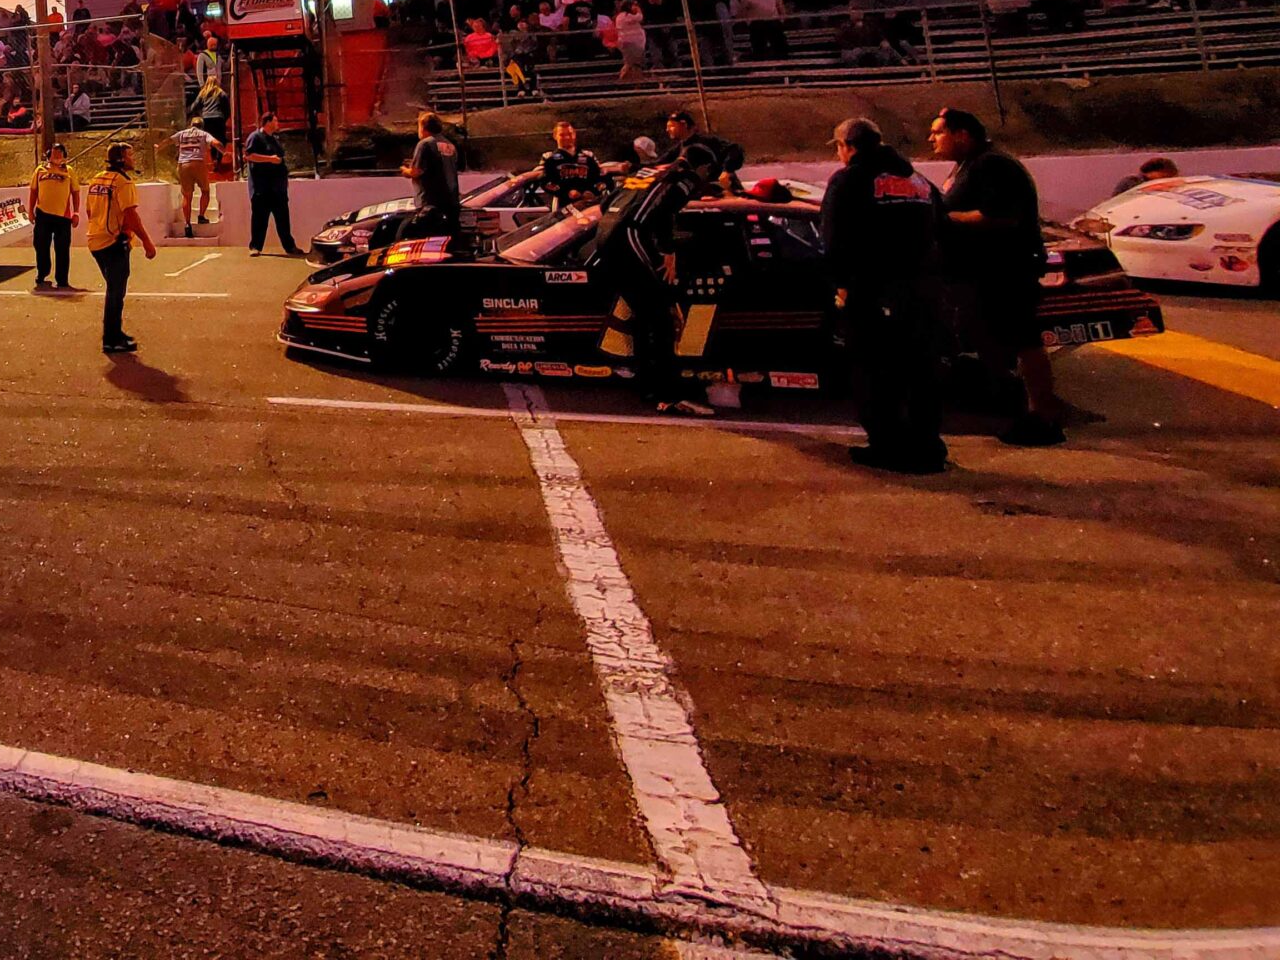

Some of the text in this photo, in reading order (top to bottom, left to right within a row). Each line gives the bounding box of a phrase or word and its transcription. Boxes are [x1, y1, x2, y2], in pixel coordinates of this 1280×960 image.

[3, 219, 19, 228] ROD
[547, 272, 573, 282] ARCA
[482, 298, 538, 310] SINCLAIR
[1041, 323, 1087, 346] obil
